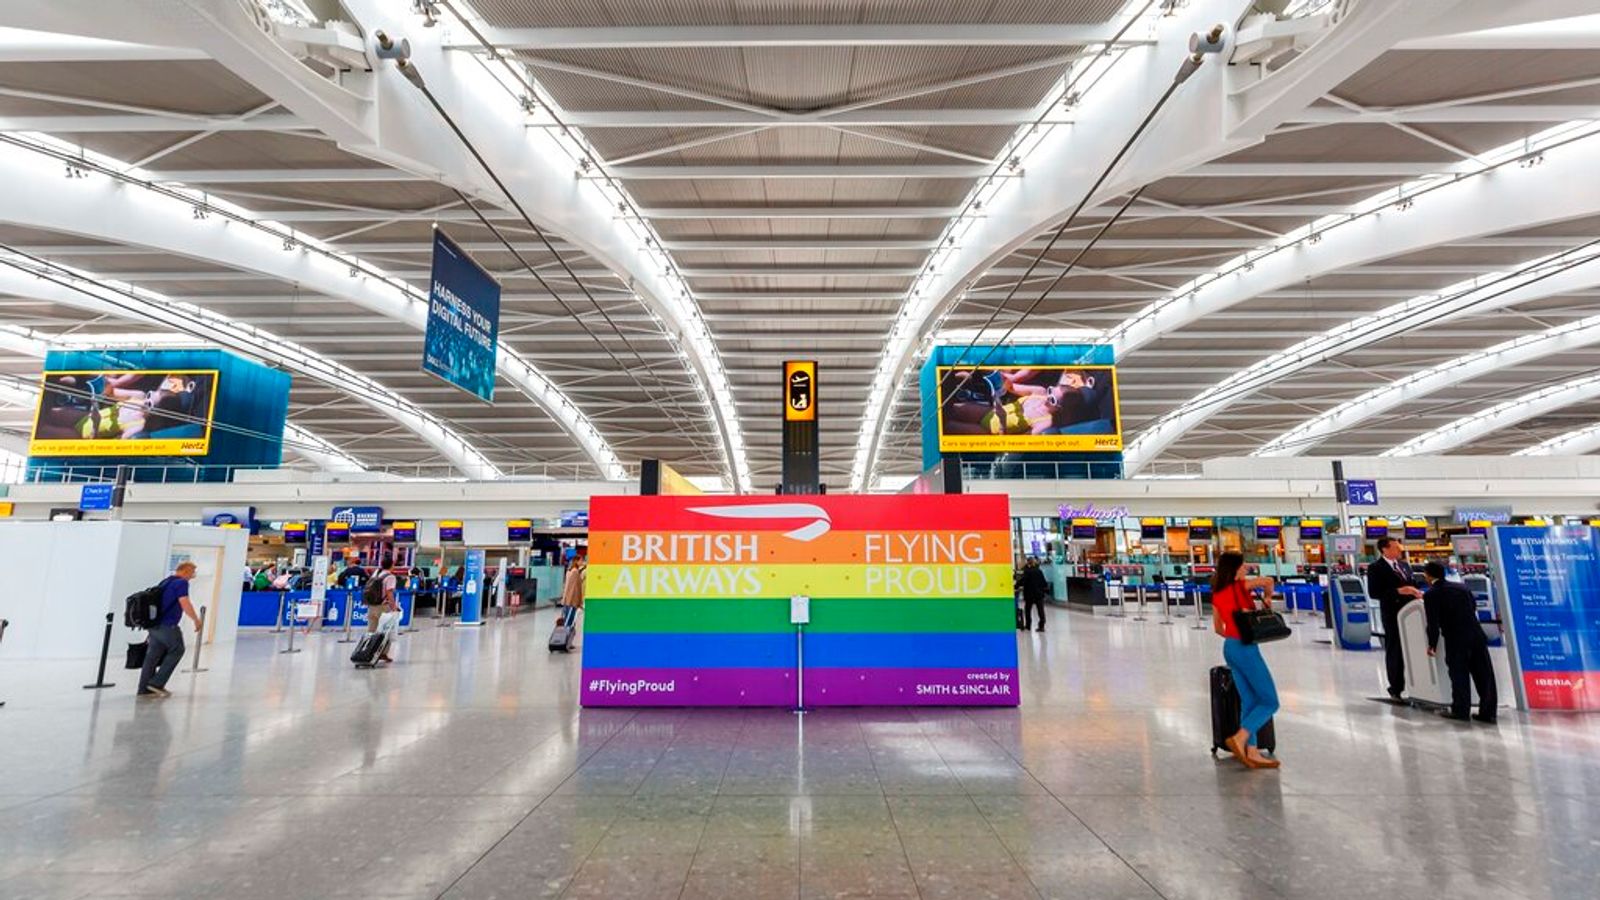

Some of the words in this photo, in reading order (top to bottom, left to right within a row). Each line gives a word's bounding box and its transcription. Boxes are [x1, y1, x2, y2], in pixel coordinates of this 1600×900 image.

[433, 280, 472, 319] HARNESS
[472, 310, 492, 333] YOUR
[432, 299, 463, 332] DIGITAL
[464, 322, 493, 353] FUTURE
[180, 442, 205, 451] Hertz
[969, 440, 987, 449] great
[1055, 440, 1067, 448] get
[1094, 438, 1119, 446] Hertz
[58, 444, 76, 453] great
[143, 444, 155, 452] get
[1457, 511, 1510, 522] WHSmith
[622, 534, 758, 561] BRITISH
[865, 533, 984, 563] FLYING
[612, 566, 762, 595] AIRWAYS
[865, 566, 987, 595] PROUD
[967, 672, 998, 680] created
[999, 672, 1010, 682] by
[1535, 678, 1572, 686] IBERIA
[589, 679, 675, 695] #FlyingProud
[916, 684, 950, 695] SMITH
[951, 686, 959, 695] &
[959, 684, 1011, 695] SINCLAIR
